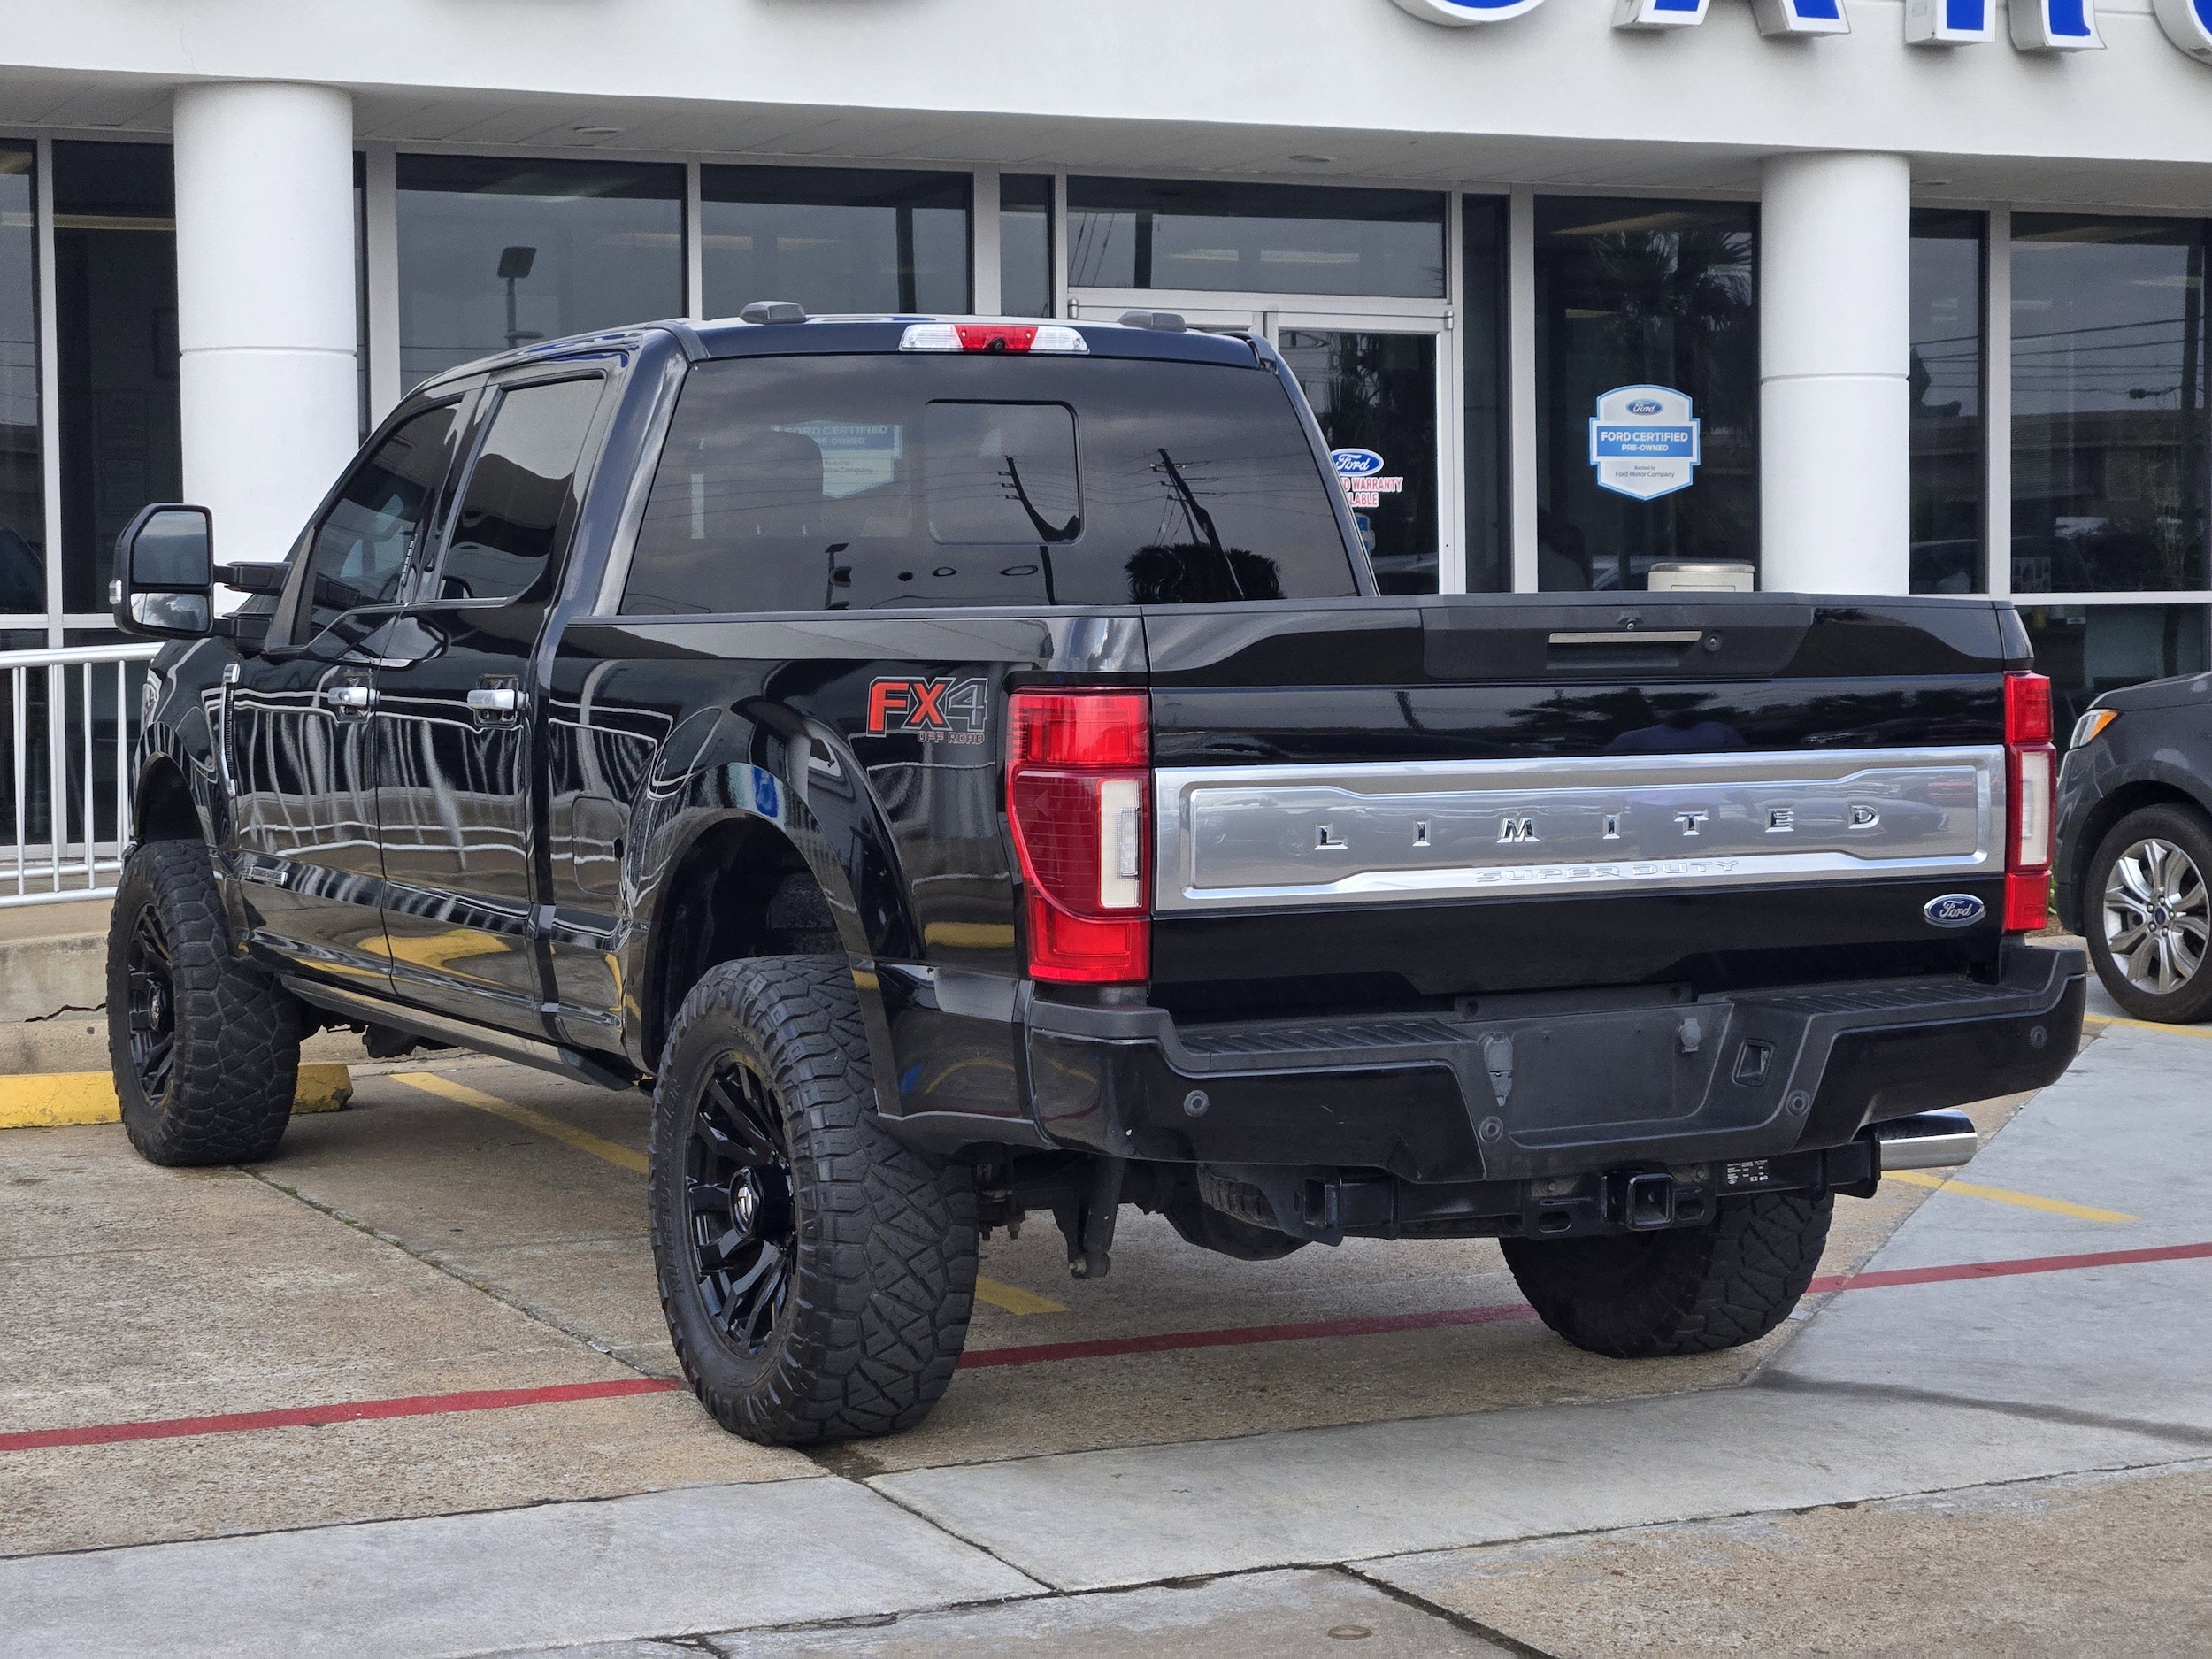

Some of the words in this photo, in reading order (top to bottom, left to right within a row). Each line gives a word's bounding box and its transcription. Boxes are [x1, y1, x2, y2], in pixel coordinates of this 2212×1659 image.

[1632, 402, 1656, 412] Ford
[1601, 431, 1631, 442] FORD
[1632, 432, 1688, 442] CERTIFIED
[1335, 453, 1371, 471] Ford
[1352, 478, 1402, 490] WARRANTY
[1349, 493, 1378, 505] LABLE
[866, 676, 988, 738] FX4
[917, 731, 944, 743] OFF
[948, 731, 985, 744] ROAD
[1475, 864, 1621, 883] SUPER
[1632, 860, 1739, 876] DUTY
[1939, 900, 1973, 918] Ford
